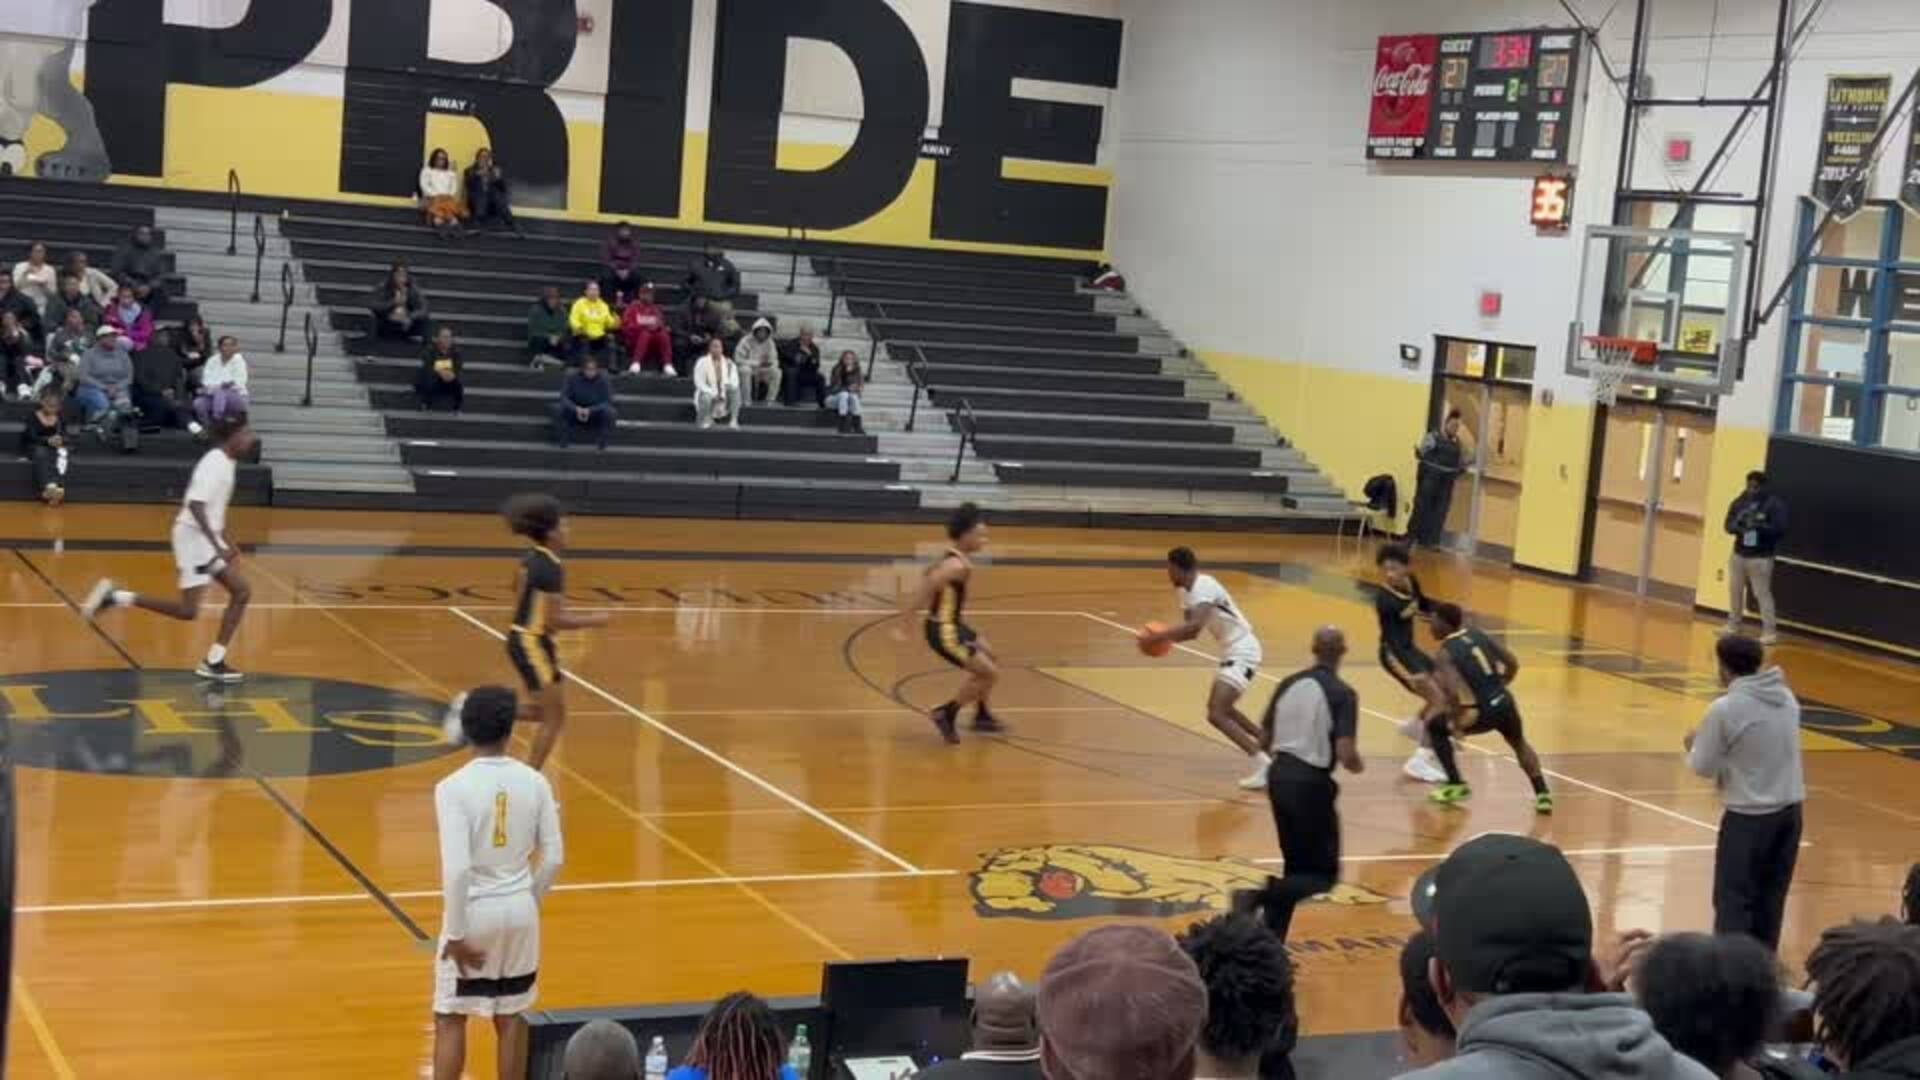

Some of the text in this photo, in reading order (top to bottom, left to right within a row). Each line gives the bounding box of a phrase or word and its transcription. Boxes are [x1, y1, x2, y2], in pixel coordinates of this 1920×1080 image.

[431, 96, 467, 110] AWAY
[1507, 78, 1520, 102] 2
[84, 0, 1122, 251] PRIDE
[921, 144, 951, 157] AWAY
[1472, 646, 1493, 674] 1
[0, 685, 449, 747] LHS
[494, 791, 508, 847] 1
